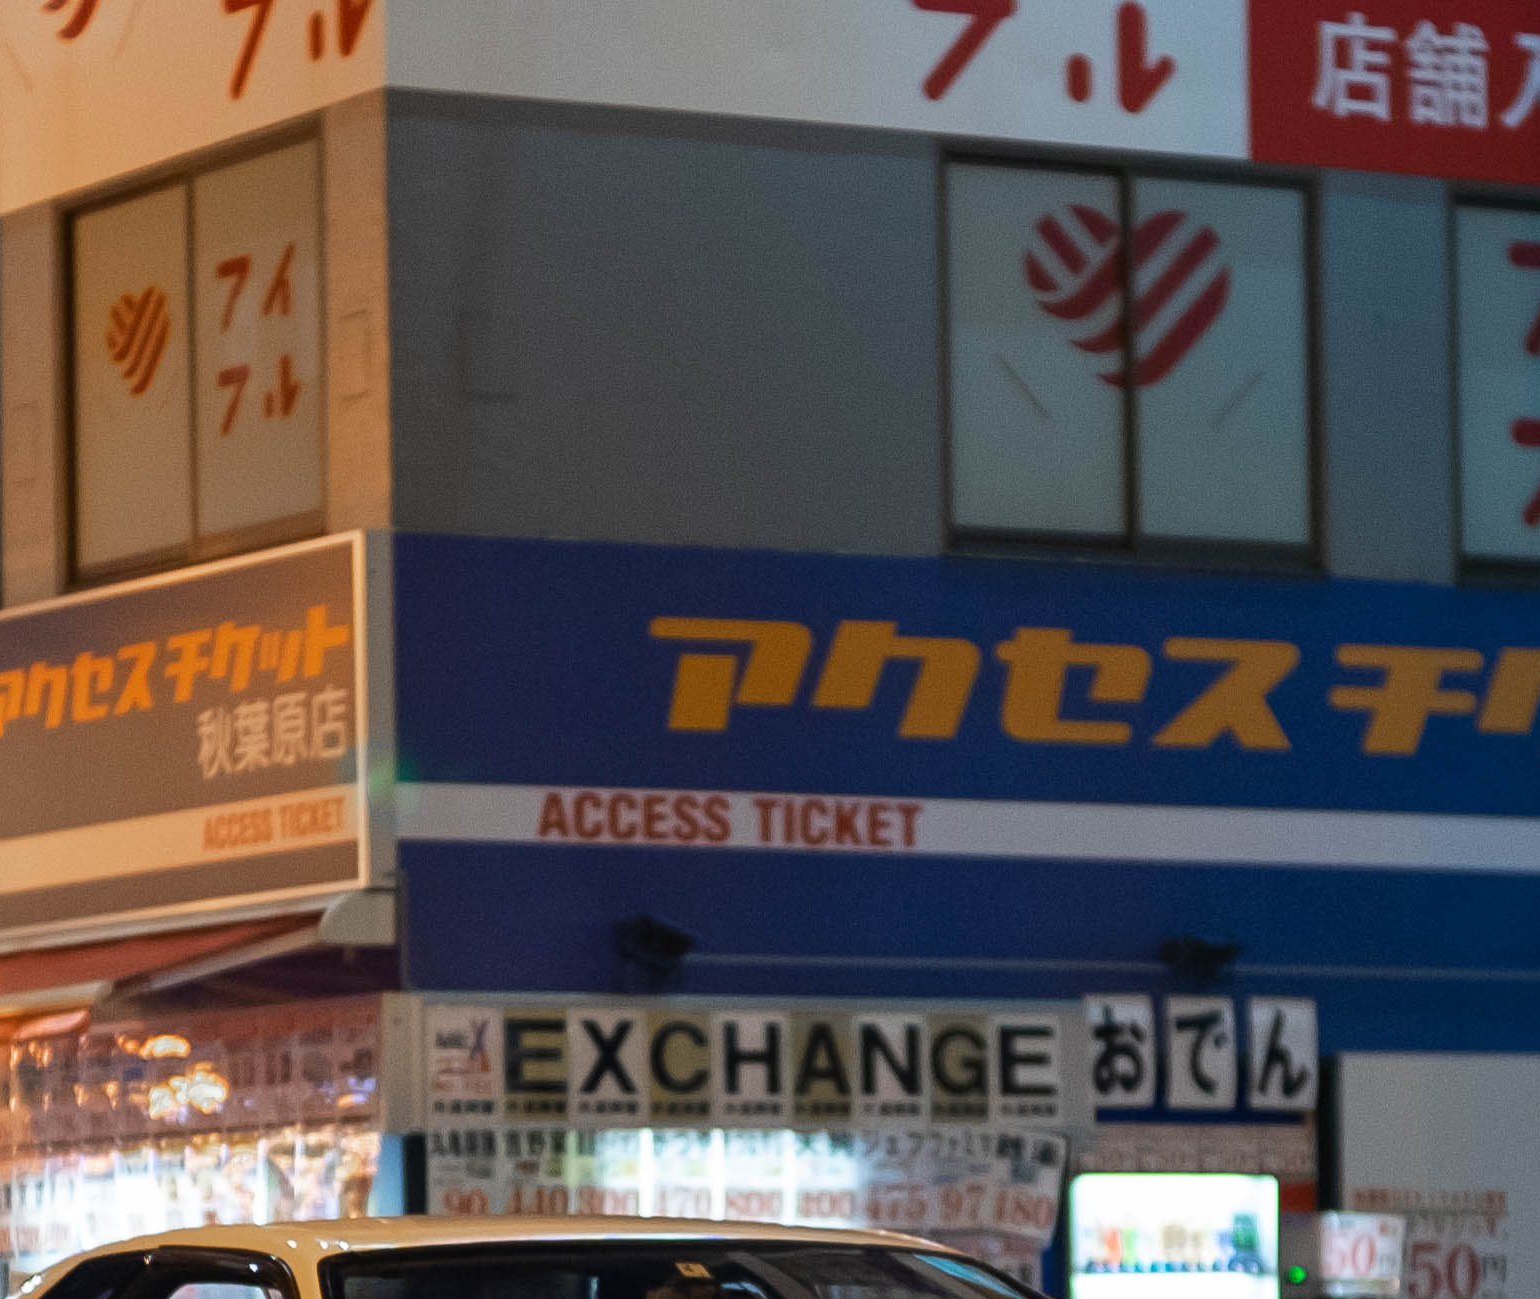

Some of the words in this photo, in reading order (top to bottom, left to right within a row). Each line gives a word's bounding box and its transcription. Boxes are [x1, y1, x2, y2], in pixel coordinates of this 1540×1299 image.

[196, 685, 349, 781] 秋葉原店
[202, 806, 273, 852] ACCESS
[280, 796, 345, 839] TICKET
[538, 793, 732, 845] ACCESS
[752, 798, 924, 851] TICKET
[504, 1017, 1057, 1097] EXCHANGE
[1092, 1005, 1309, 1099] おでん
